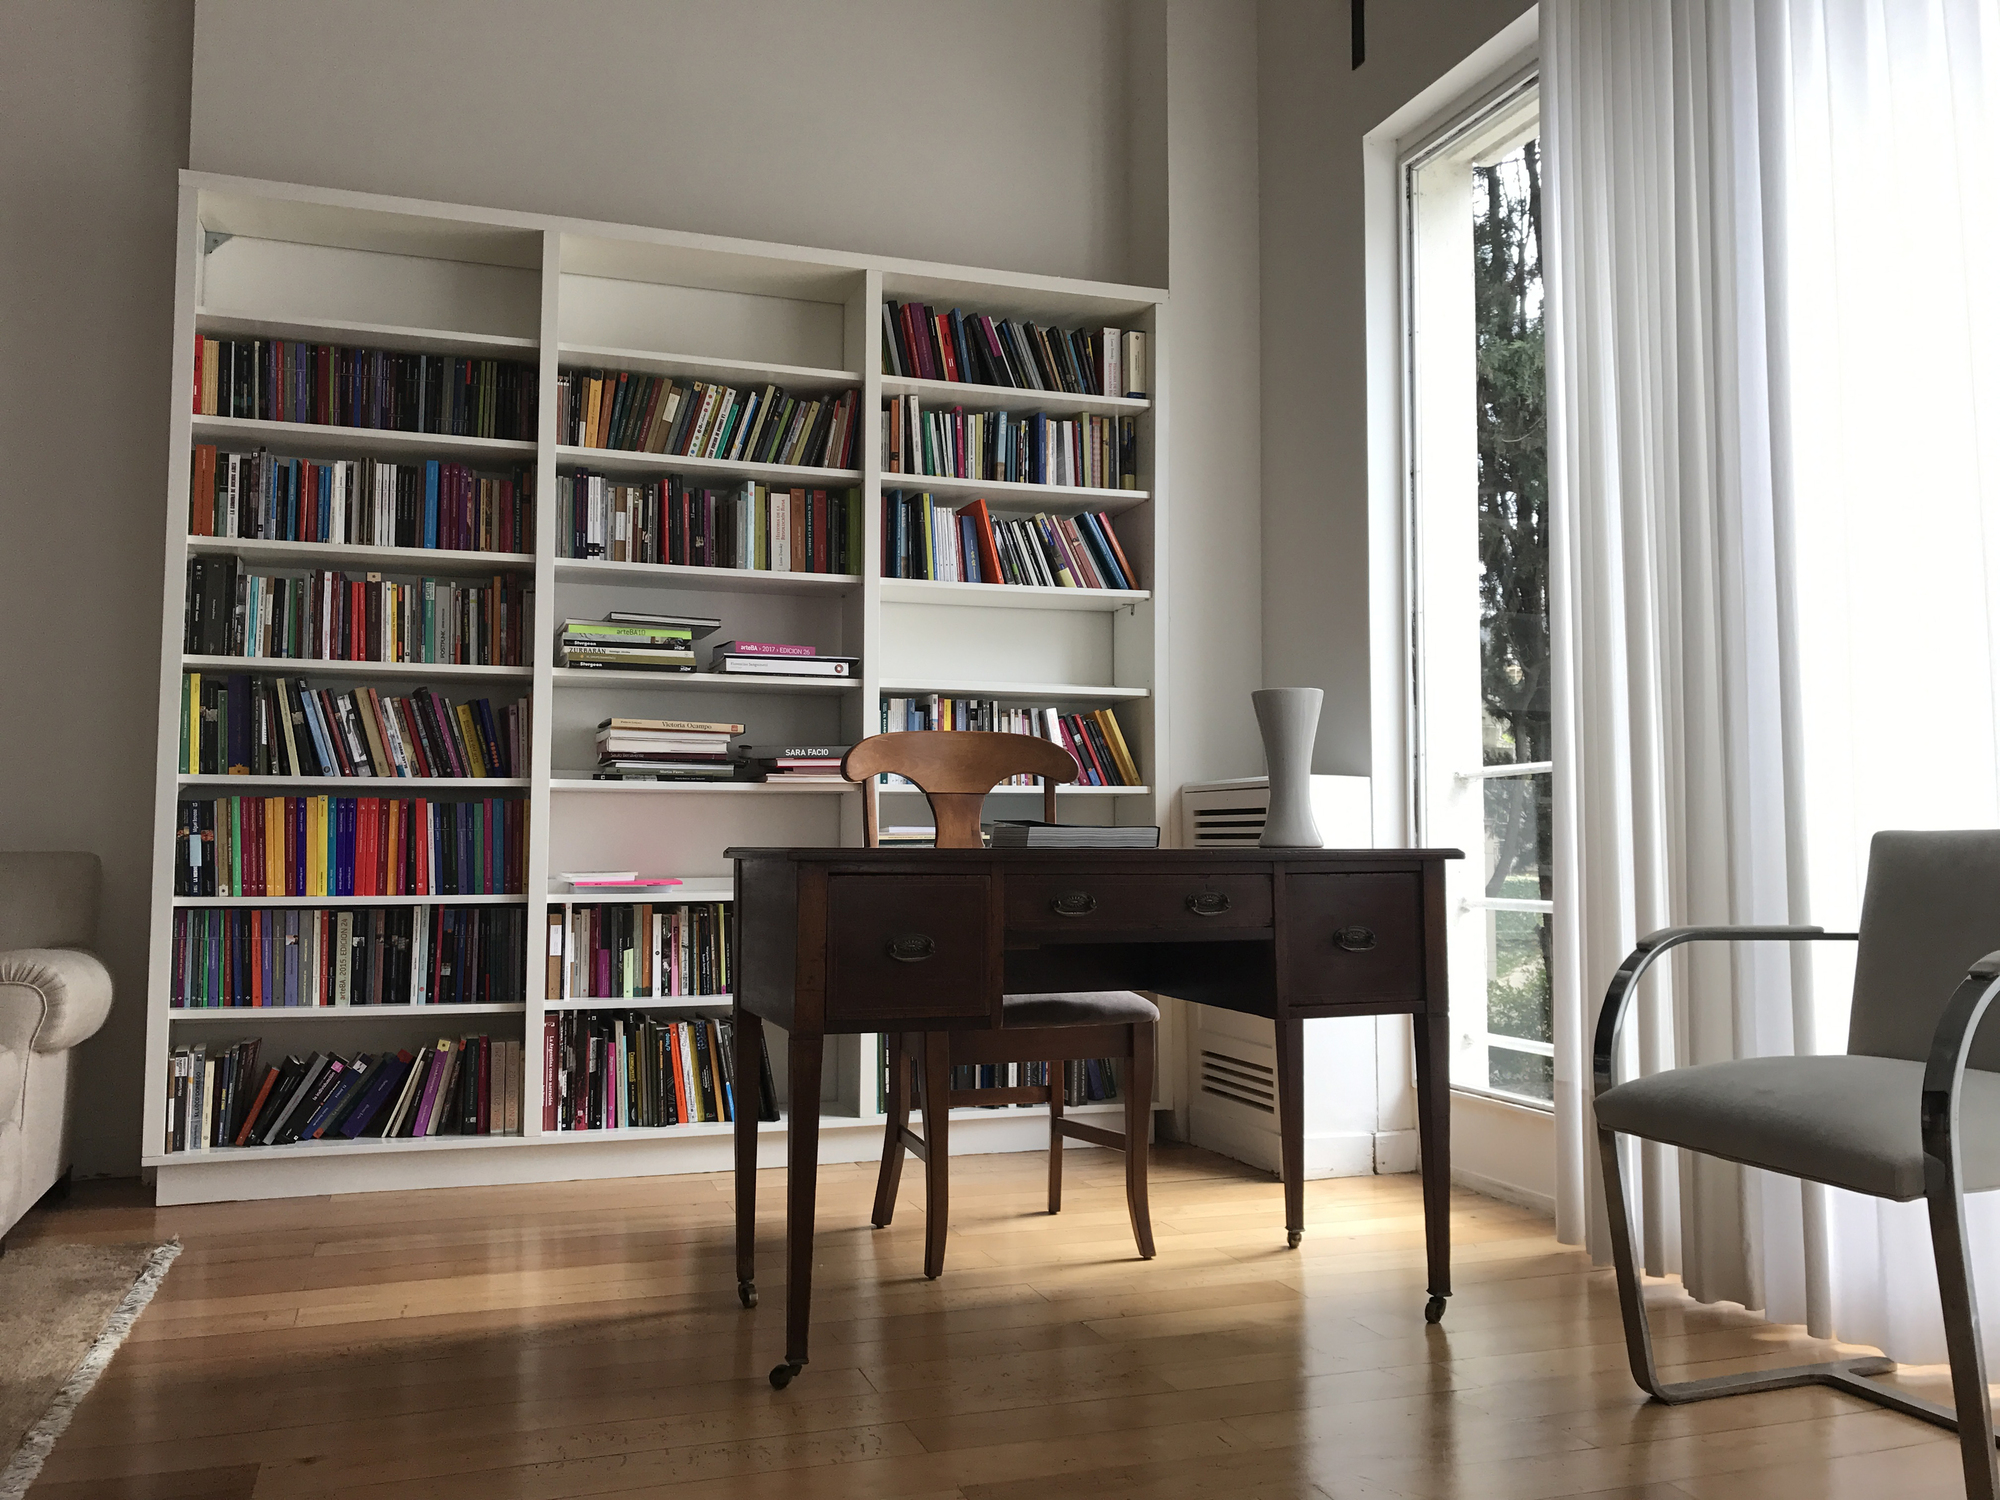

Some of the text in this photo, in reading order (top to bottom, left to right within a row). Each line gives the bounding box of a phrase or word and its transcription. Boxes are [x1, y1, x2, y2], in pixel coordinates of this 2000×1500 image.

[780, 647, 802, 655] EDICION
[687, 722, 712, 730] Ocampo
[807, 748, 829, 756] FACIO
[341, 918, 347, 926] 24
[315, 1071, 336, 1097] individuación
